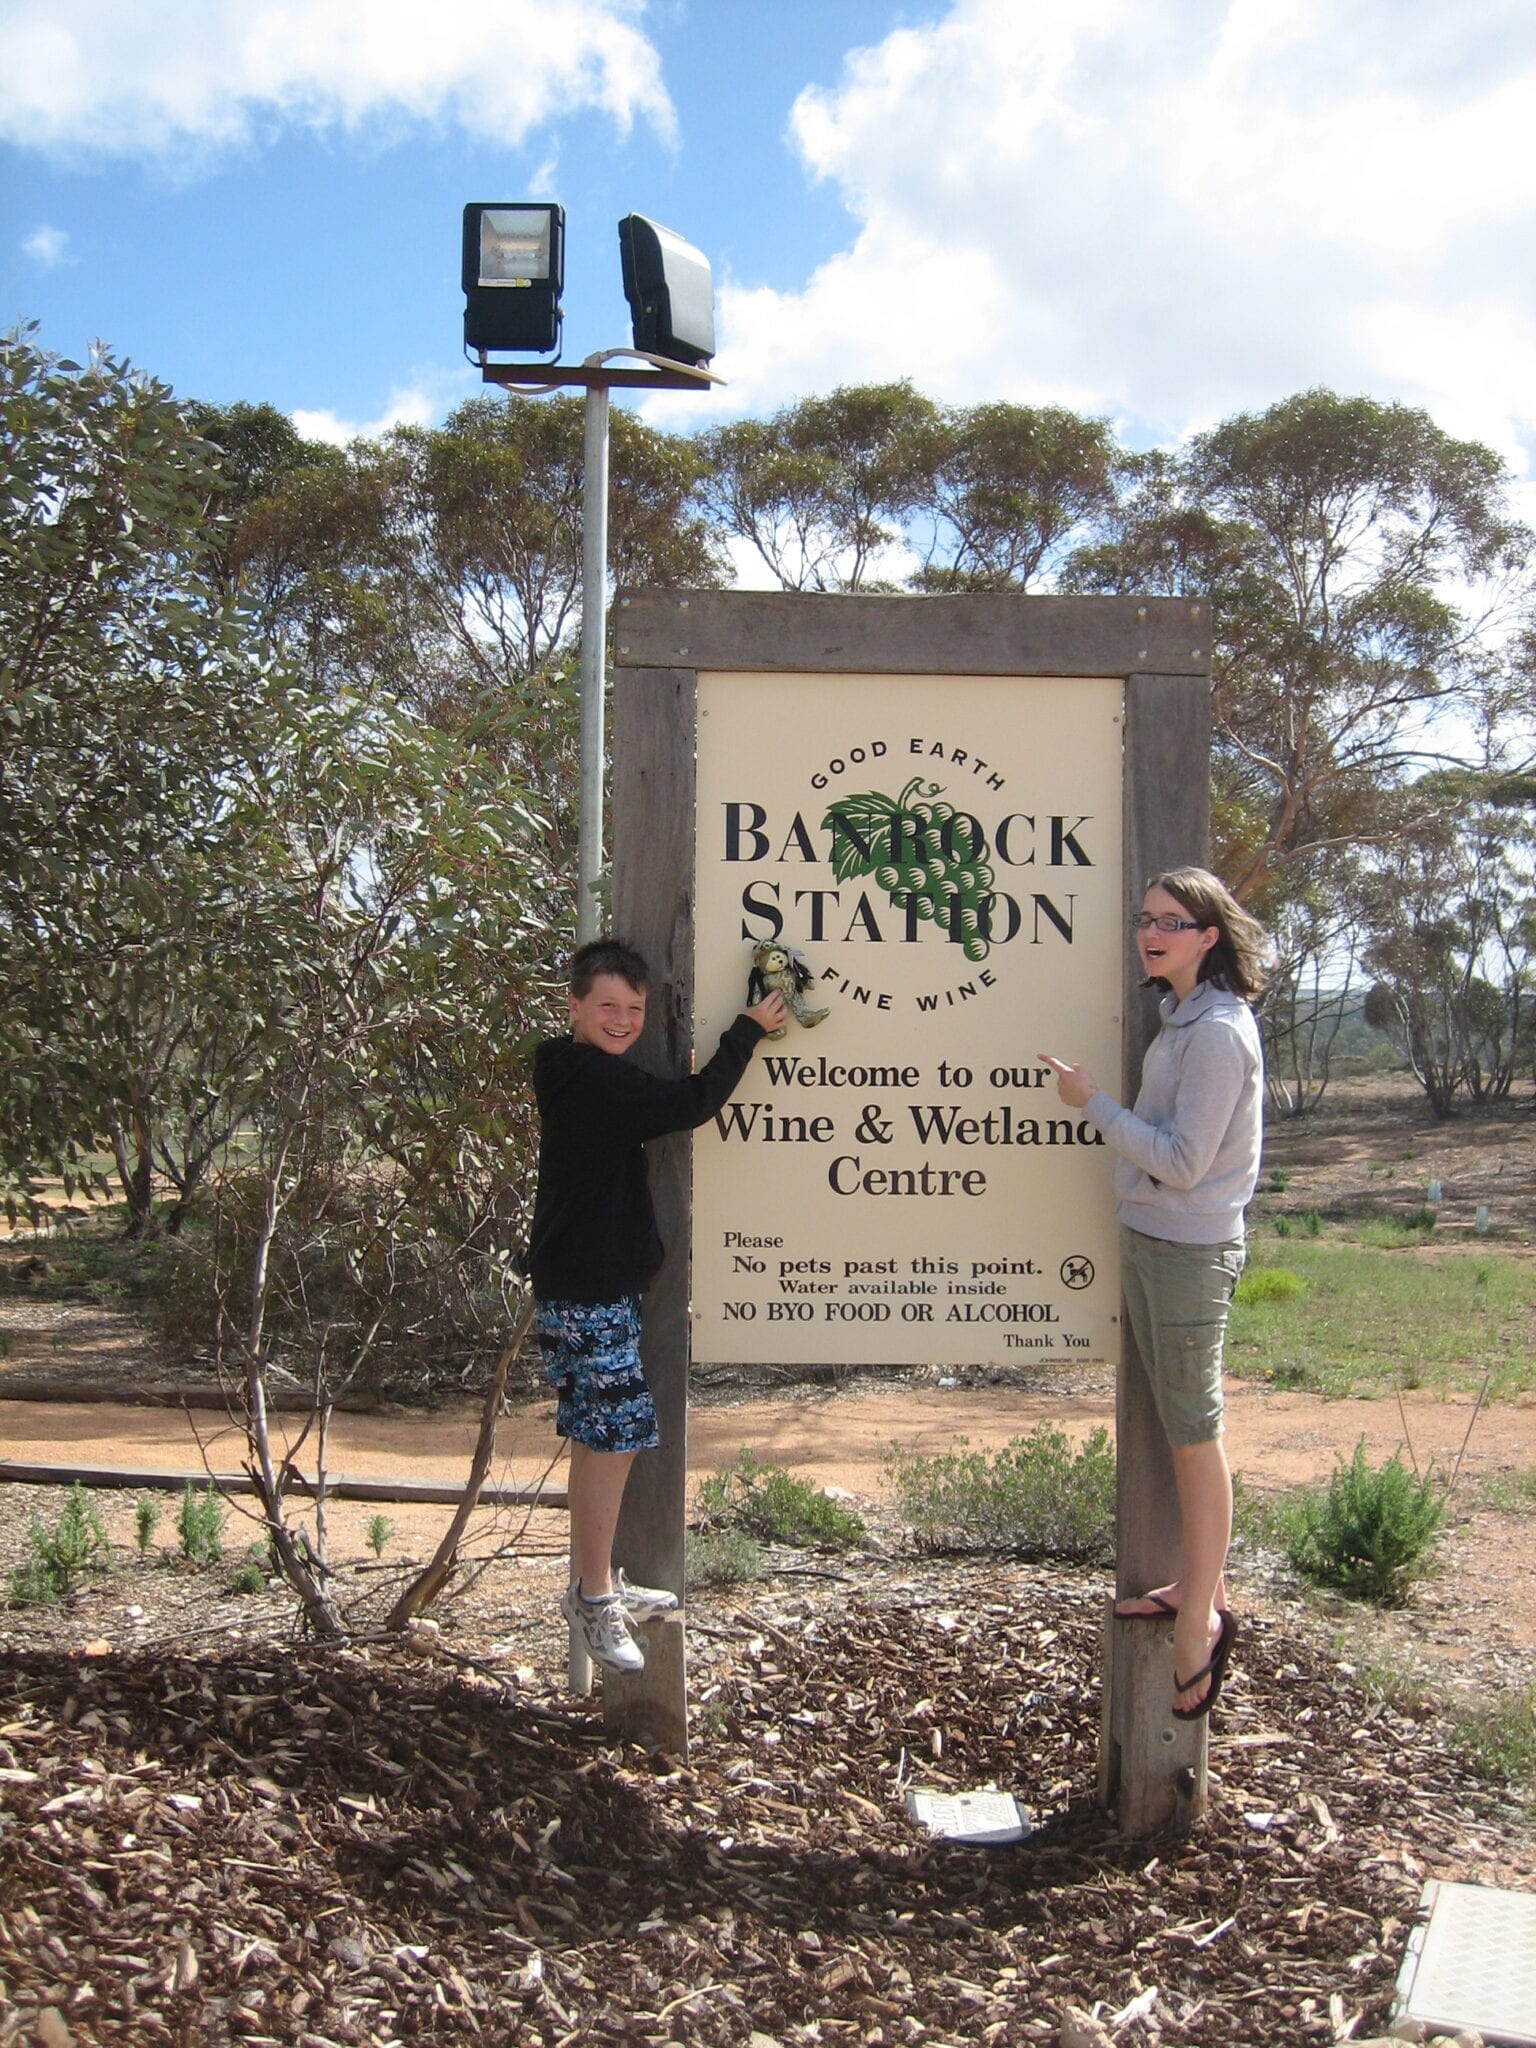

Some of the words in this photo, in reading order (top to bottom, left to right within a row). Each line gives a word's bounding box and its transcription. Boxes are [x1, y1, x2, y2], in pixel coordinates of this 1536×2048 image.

[811, 740, 888, 790] GOOD
[909, 738, 1006, 792] EARTH
[721, 801, 1096, 867] BANROCK
[741, 880, 1079, 945] STATION
[820, 967, 893, 1012] FINE
[916, 969, 997, 1012] WINE
[762, 1056, 920, 1087] Welcome
[938, 1060, 973, 1088] to
[990, 1067, 1051, 1088] our
[716, 1103, 834, 1143] Wine
[855, 1104, 894, 1144] &
[828, 1155, 987, 1196] Centre
[723, 1232, 784, 1248] Please
[732, 1256, 766, 1273] No
[779, 1258, 831, 1278] pets
[844, 1258, 898, 1278] past
[911, 1256, 959, 1274] this
[971, 1257, 1043, 1278] point.
[780, 1280, 838, 1294] Water
[848, 1280, 938, 1294] available
[948, 1281, 1007, 1295] inside
[722, 1302, 756, 1321] NO
[767, 1303, 814, 1321] BYO
[824, 1303, 891, 1322] FOOD
[901, 1304, 933, 1322] OR
[946, 1304, 1060, 1322] ALCOHOL
[1003, 1334, 1054, 1348] Thank
[1062, 1334, 1090, 1348] You
